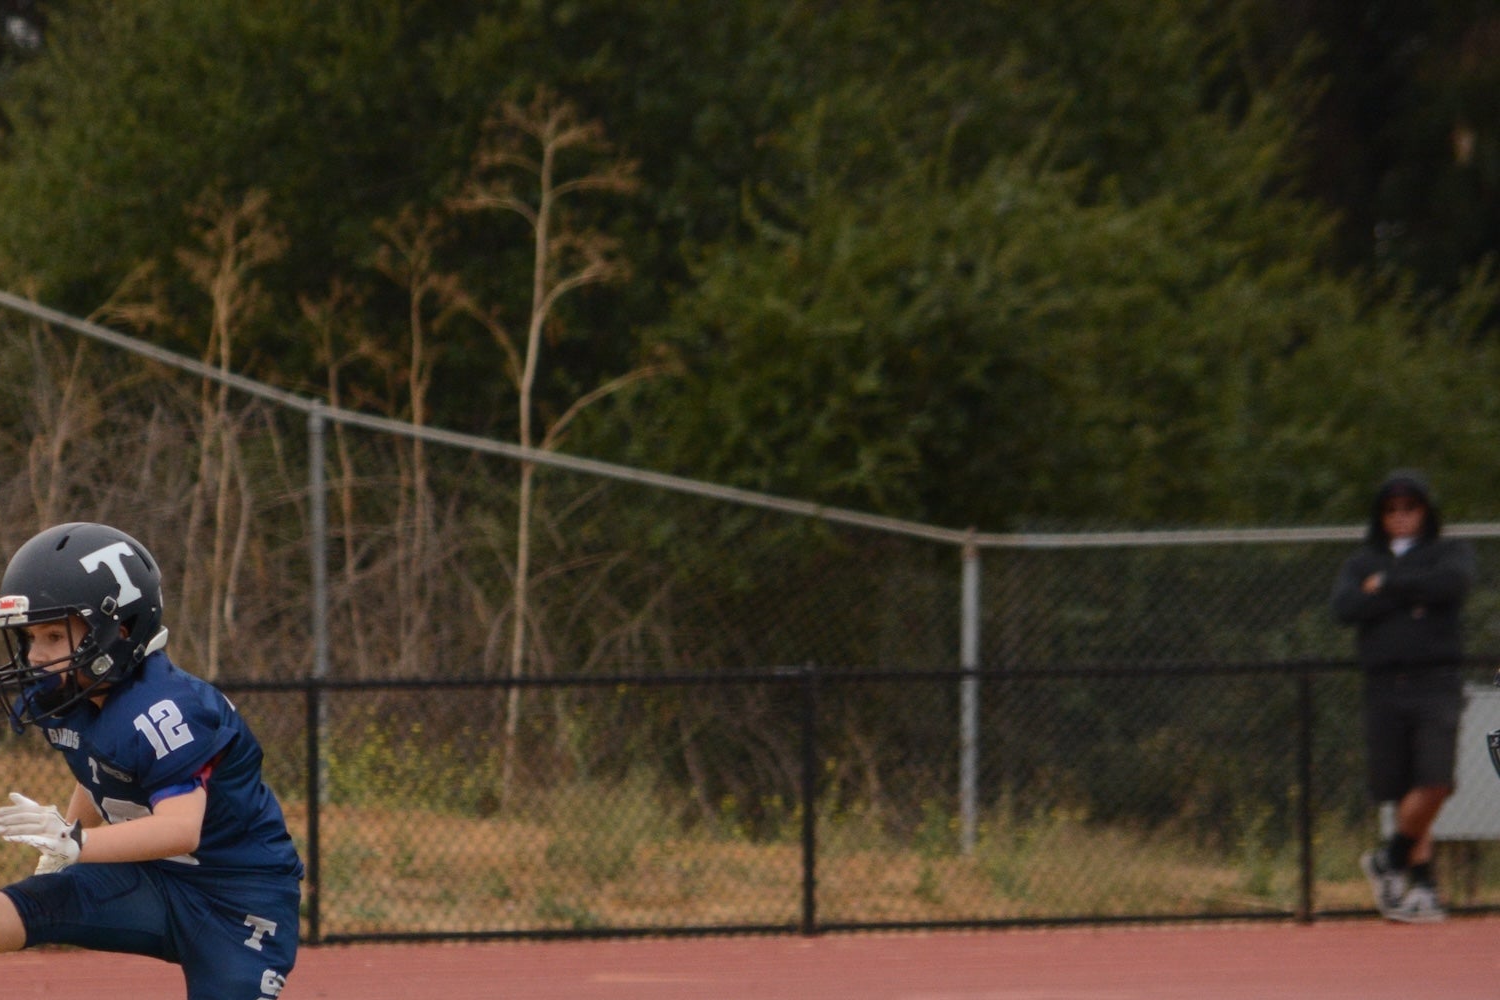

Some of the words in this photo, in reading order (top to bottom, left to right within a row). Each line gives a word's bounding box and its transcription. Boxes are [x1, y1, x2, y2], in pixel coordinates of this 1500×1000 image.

[79, 541, 142, 608] T
[134, 700, 194, 760] 12
[244, 914, 277, 951] T
